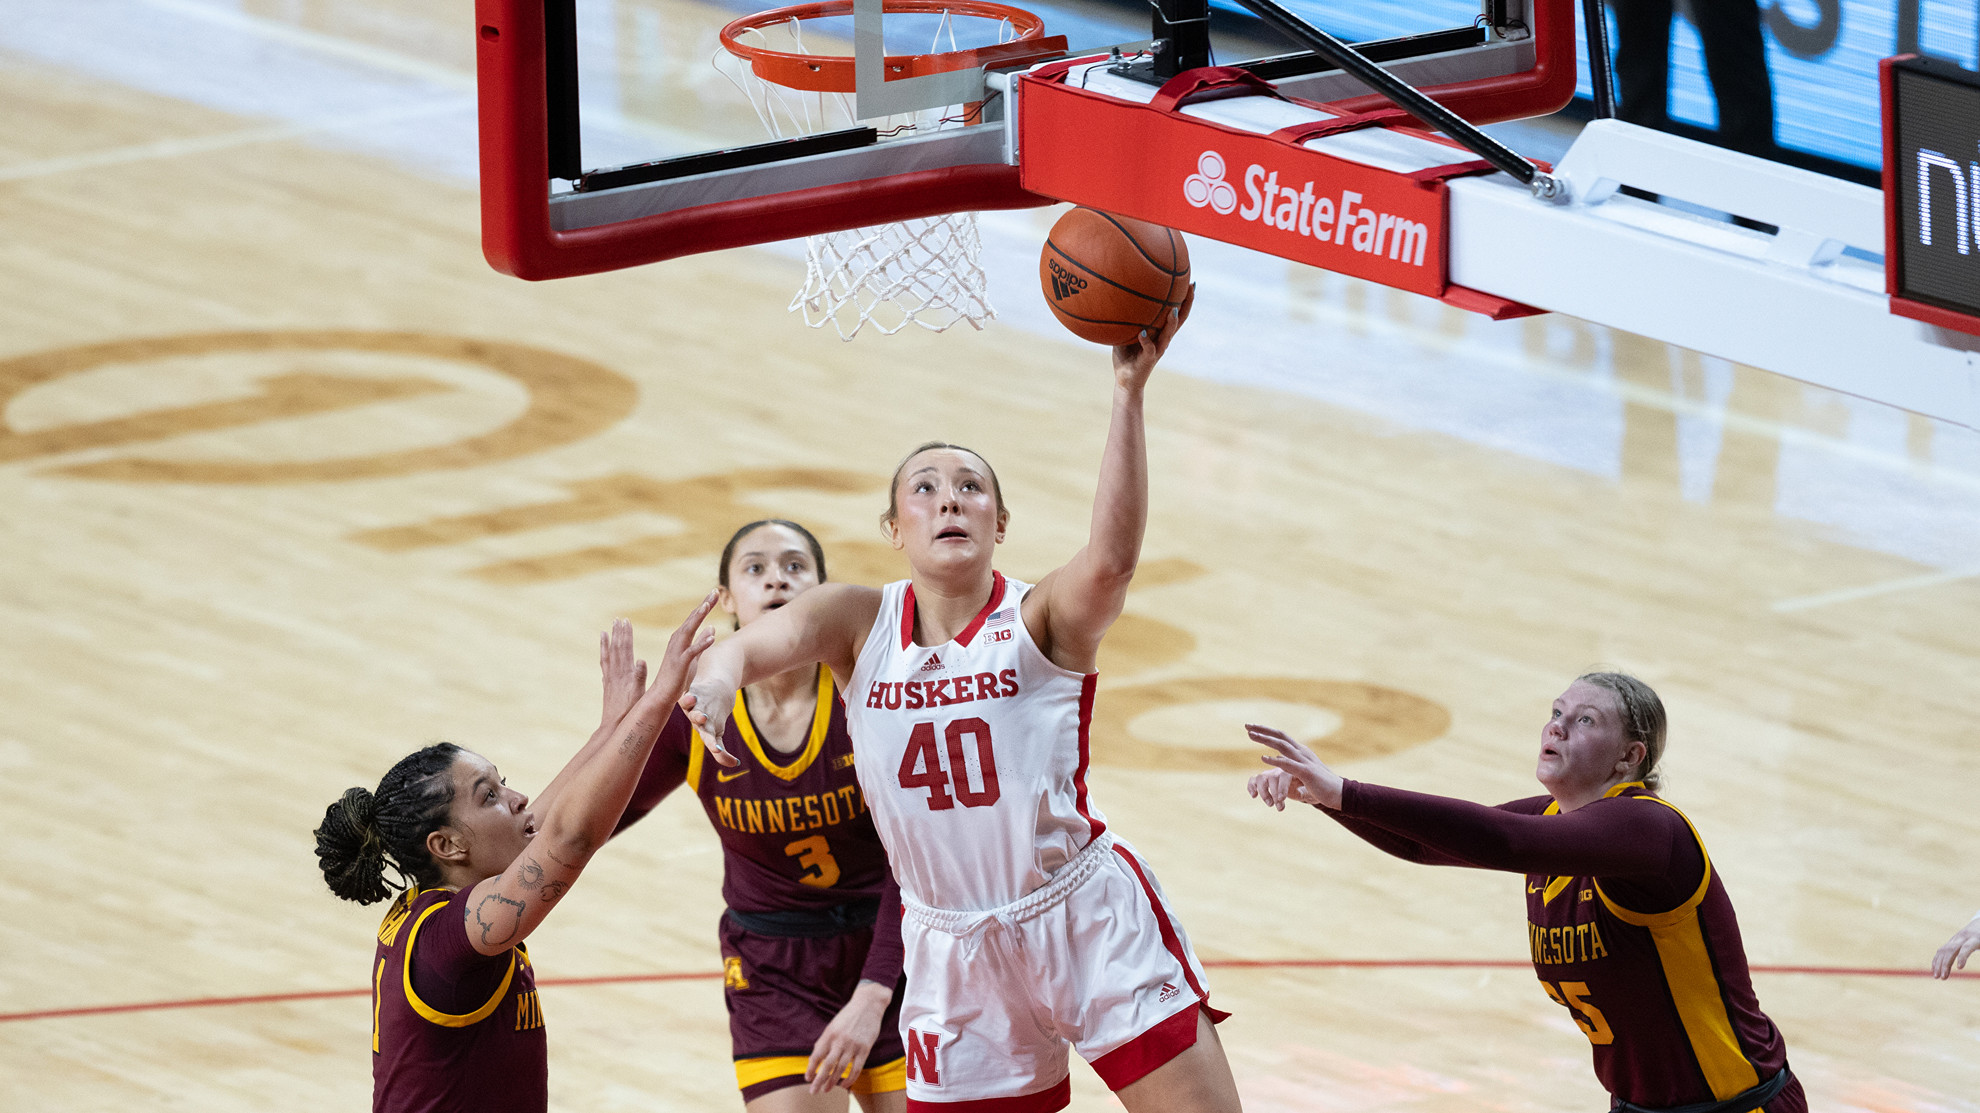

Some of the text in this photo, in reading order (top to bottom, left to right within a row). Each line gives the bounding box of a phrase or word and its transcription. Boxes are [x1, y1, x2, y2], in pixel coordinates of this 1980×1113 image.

[1049, 258, 1088, 290] adidas
[866, 669, 1019, 711] HUSKERS
[920, 662, 945, 672] adidas
[897, 717, 1001, 811] 40
[784, 834, 841, 889] 3
[906, 1026, 942, 1087] N
